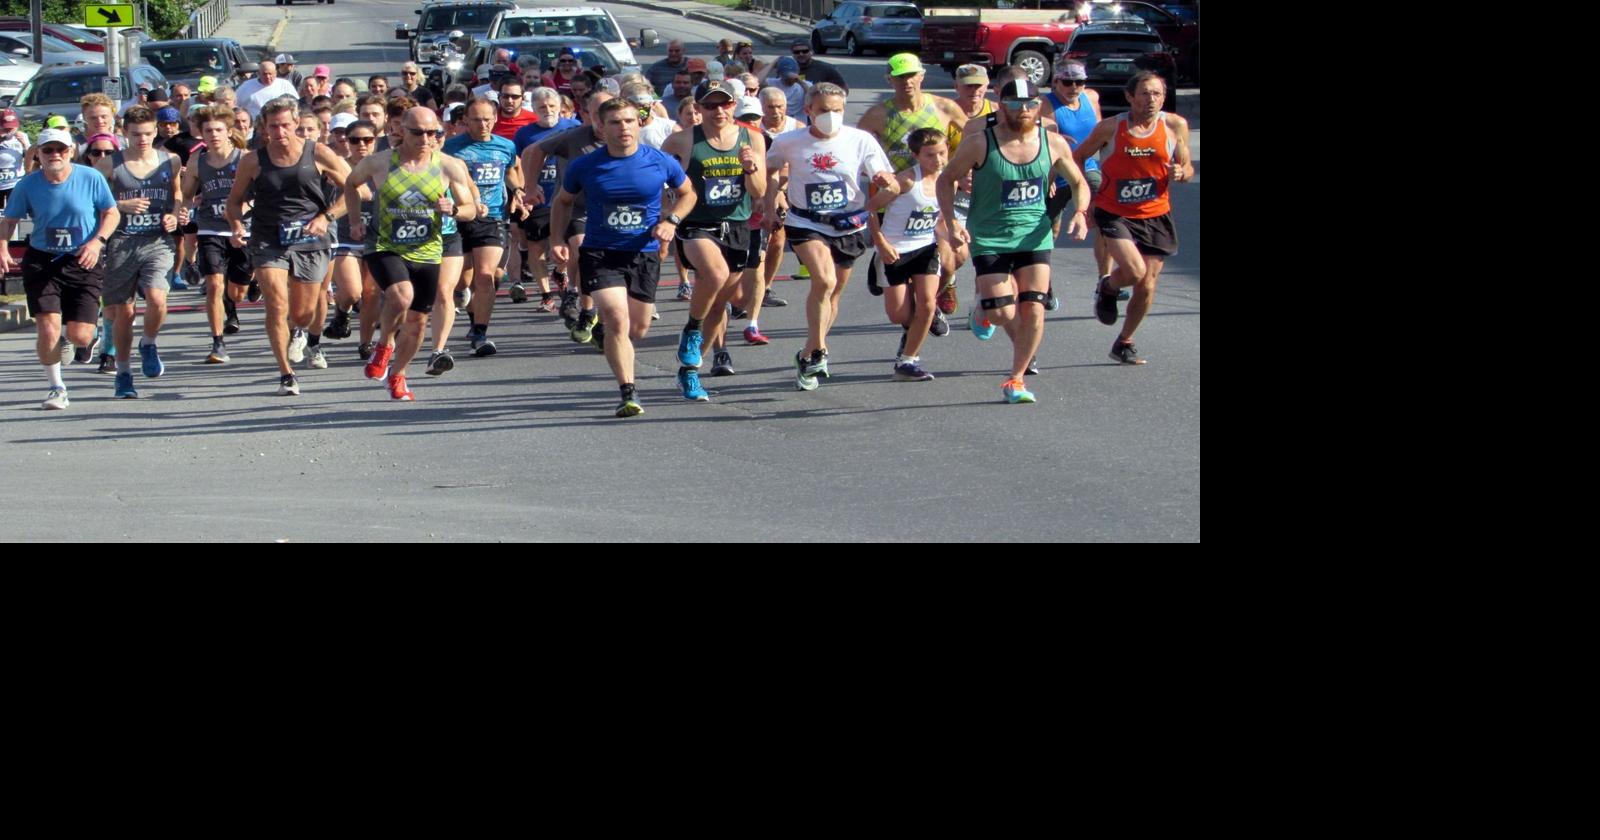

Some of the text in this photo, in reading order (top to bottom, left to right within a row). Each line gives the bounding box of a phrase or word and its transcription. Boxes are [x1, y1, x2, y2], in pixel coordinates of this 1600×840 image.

[476, 167, 500, 180] 752
[709, 184, 741, 200] 645
[810, 188, 844, 205] 865
[1007, 185, 1039, 202] 410
[1120, 183, 1152, 199] 607
[126, 212, 161, 226] 1033
[607, 211, 642, 226] 603
[396, 224, 428, 239] 620
[55, 234, 72, 247] 71
